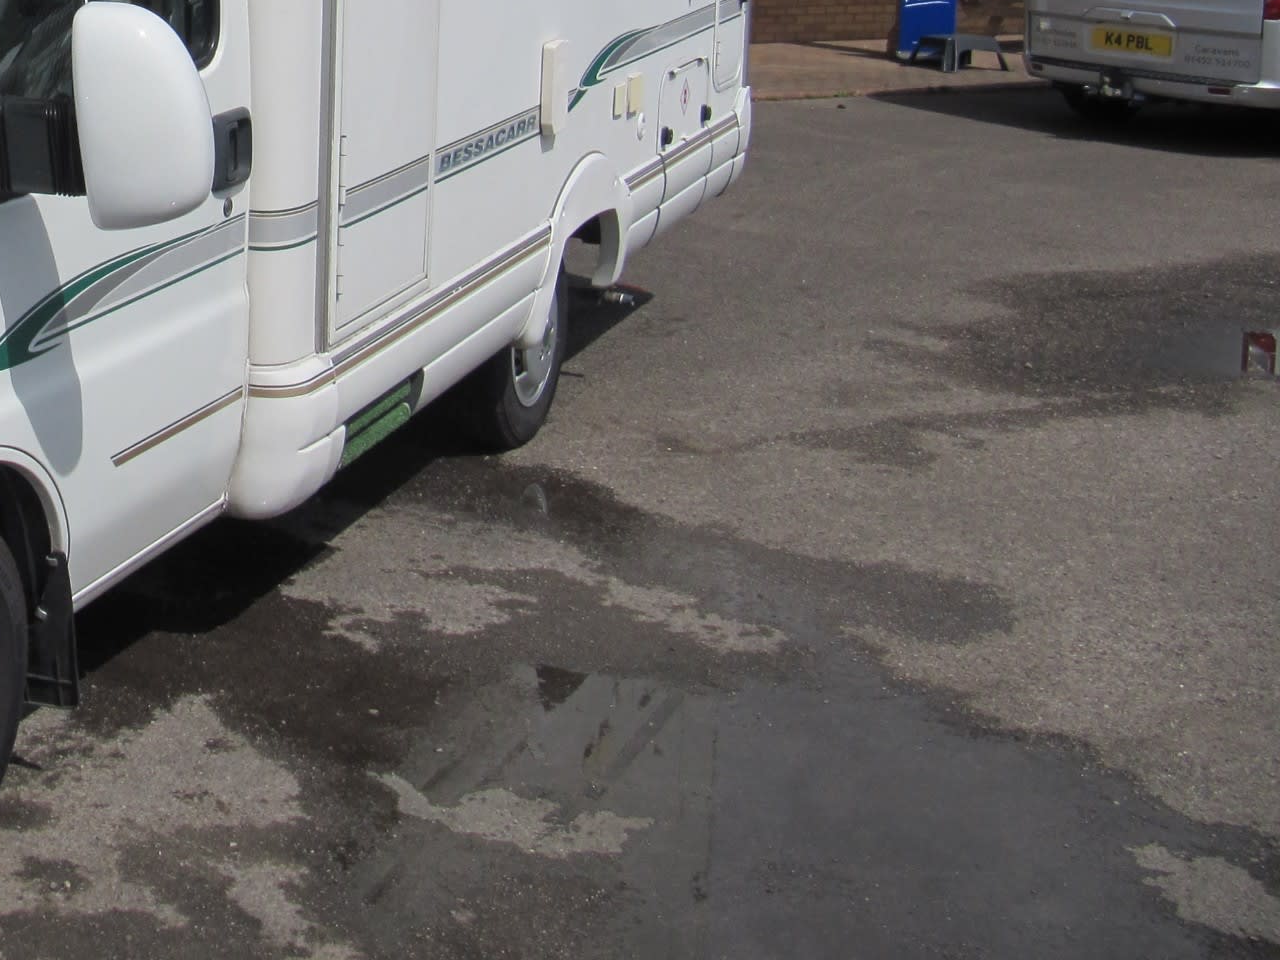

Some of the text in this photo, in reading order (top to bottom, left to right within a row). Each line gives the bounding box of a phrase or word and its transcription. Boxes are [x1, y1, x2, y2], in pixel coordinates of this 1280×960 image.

[1105, 31, 1153, 51] K4 PBL
[438, 113, 538, 174] BESSACARR
